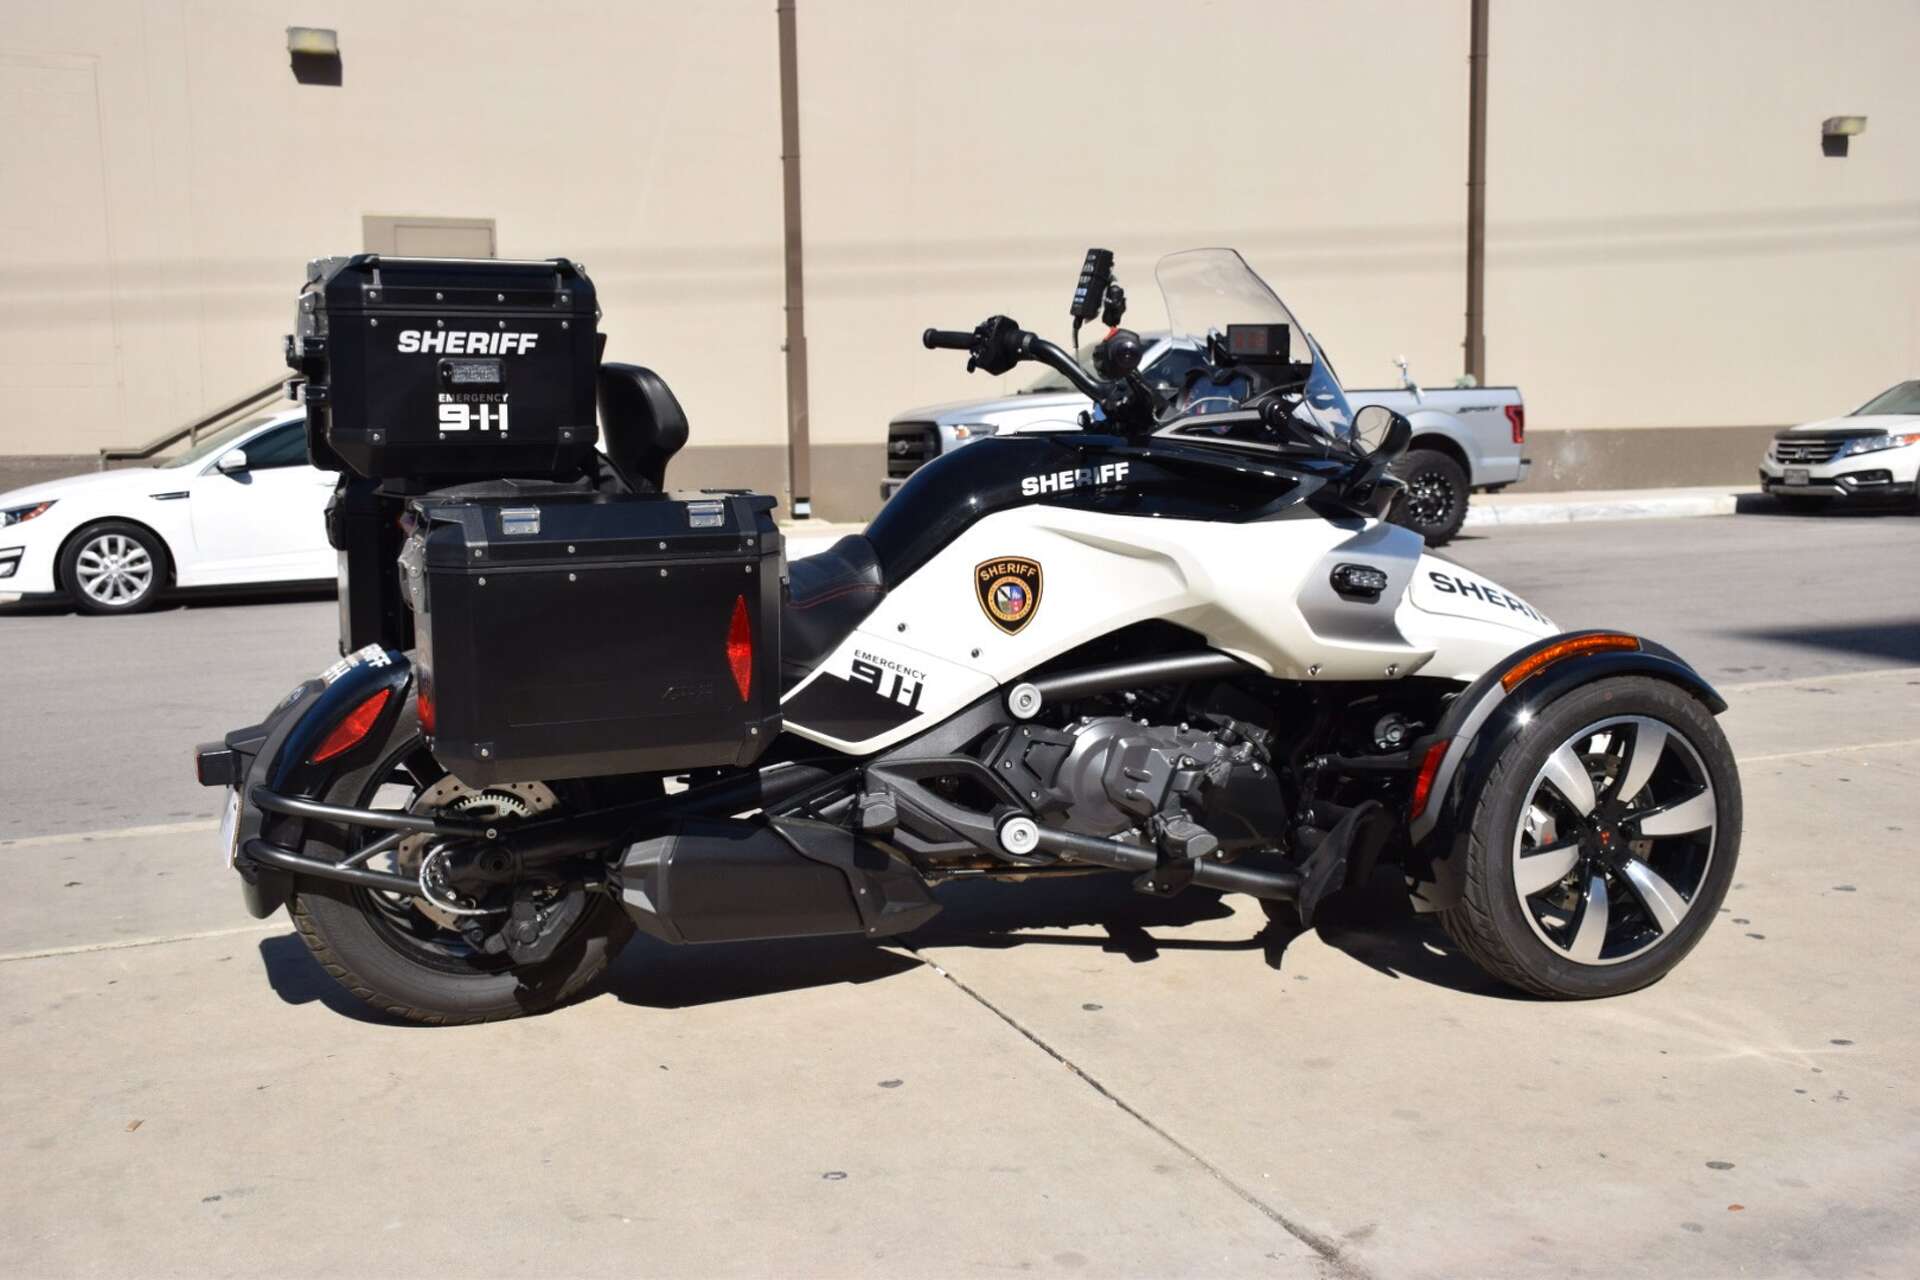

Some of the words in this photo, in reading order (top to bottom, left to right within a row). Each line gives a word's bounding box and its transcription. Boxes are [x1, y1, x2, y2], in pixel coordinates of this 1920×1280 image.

[398, 330, 538, 354] SHERIFF
[438, 393, 508, 402] EMERGENCY
[1021, 462, 1129, 496] SHERIFF
[980, 563, 1036, 580] SHERIFF
[854, 649, 927, 680] EMERGENCY
